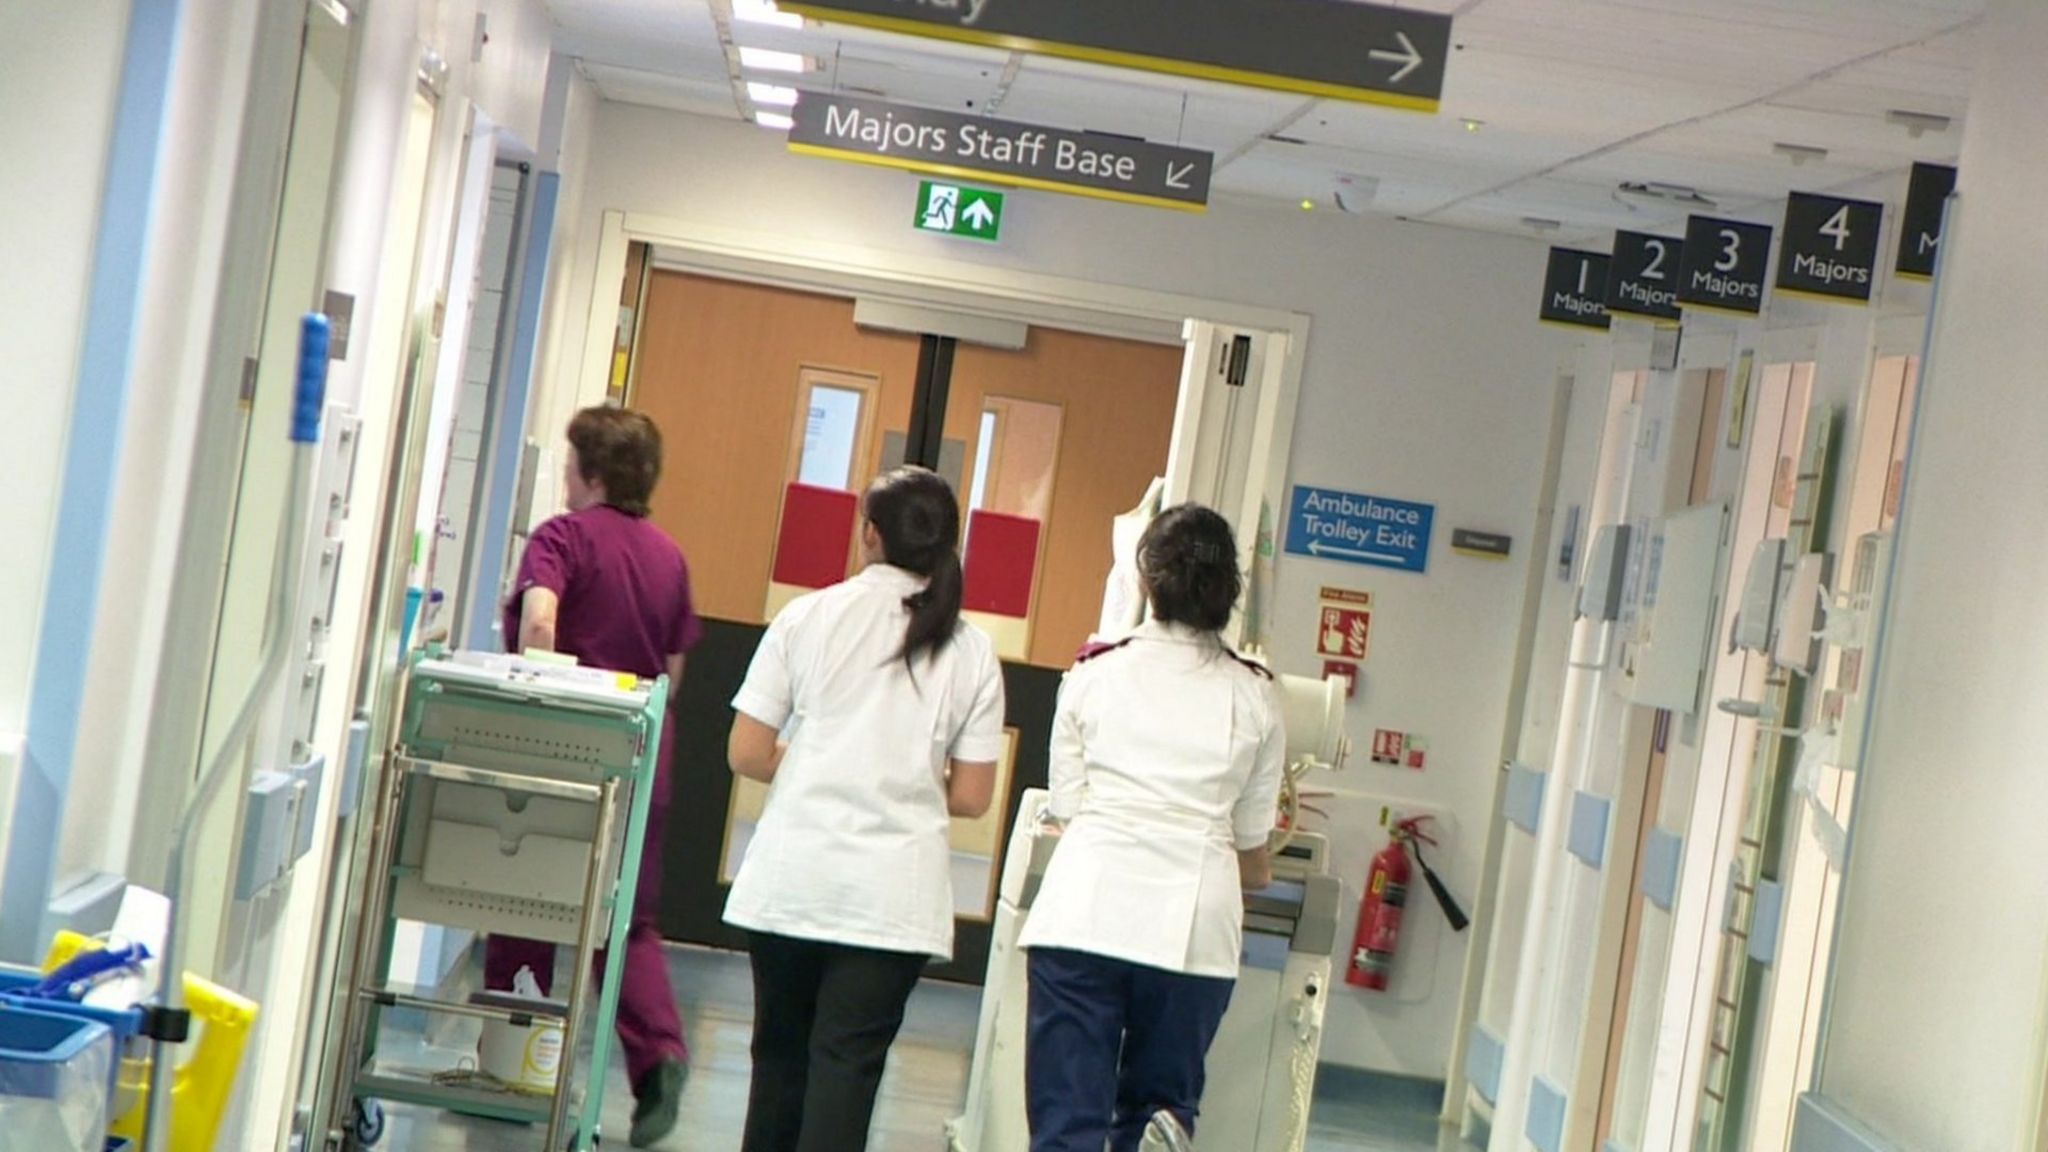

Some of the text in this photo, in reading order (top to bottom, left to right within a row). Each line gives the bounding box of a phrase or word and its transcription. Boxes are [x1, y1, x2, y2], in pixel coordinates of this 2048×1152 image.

[825, 104, 1136, 180] Majors Staff Base
[1818, 204, 1850, 250] 4
[1641, 239, 1665, 279] 2
[1714, 229, 1740, 271] 3
[1691, 270, 1758, 298] Majors
[1793, 253, 1868, 284] Majors
[1553, 291, 1606, 315] Major
[1303, 490, 1419, 525] Ambulance
[1302, 513, 1416, 549] Trolley Exit
